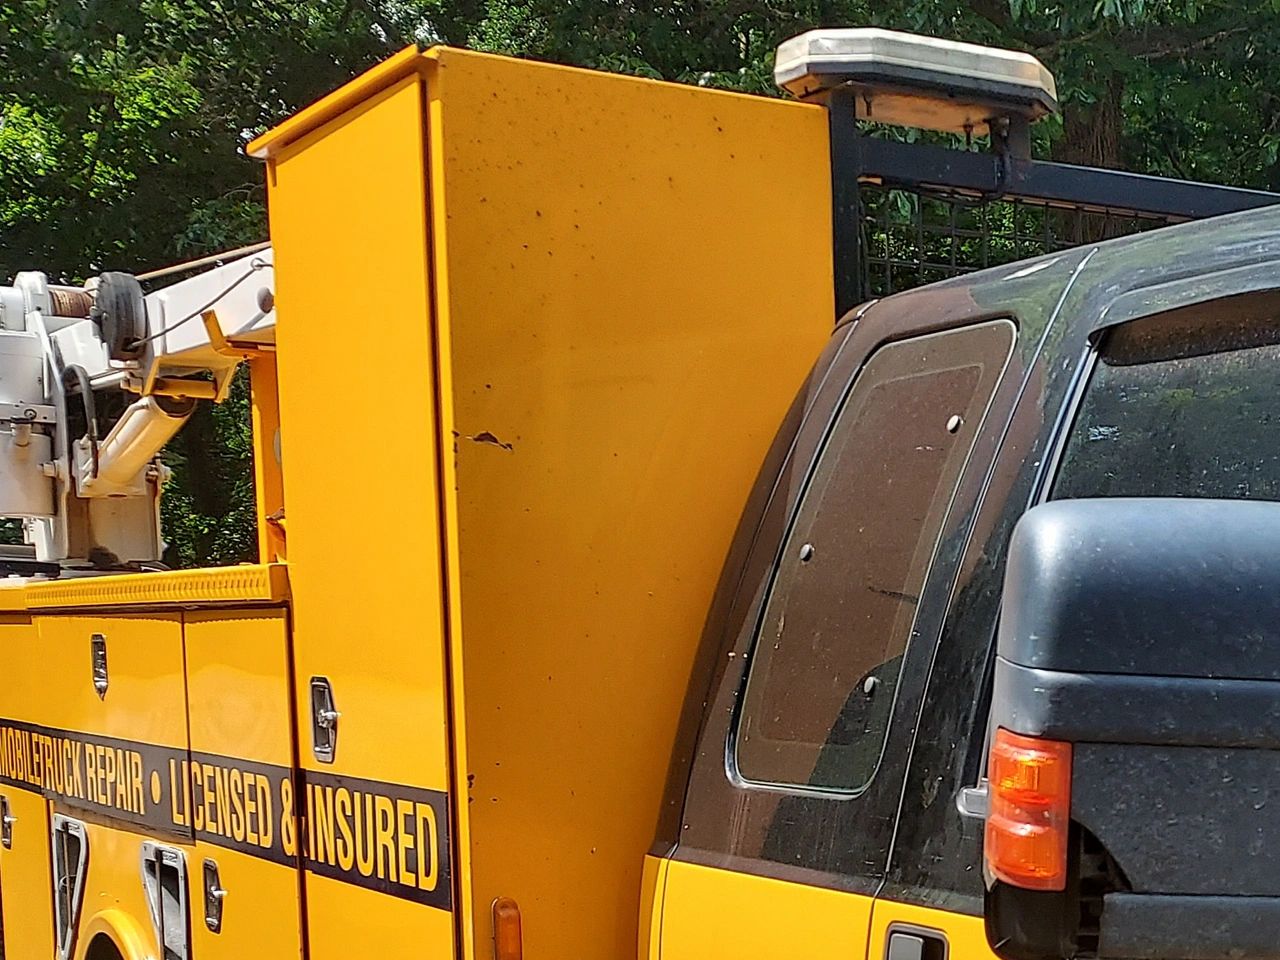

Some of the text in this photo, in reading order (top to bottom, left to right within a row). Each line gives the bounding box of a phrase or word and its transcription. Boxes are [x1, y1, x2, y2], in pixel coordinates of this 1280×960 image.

[84, 743, 146, 815] REPAIR
[169, 758, 274, 848] LICENSED
[281, 778, 308, 857] &
[306, 783, 439, 892] INSURED
